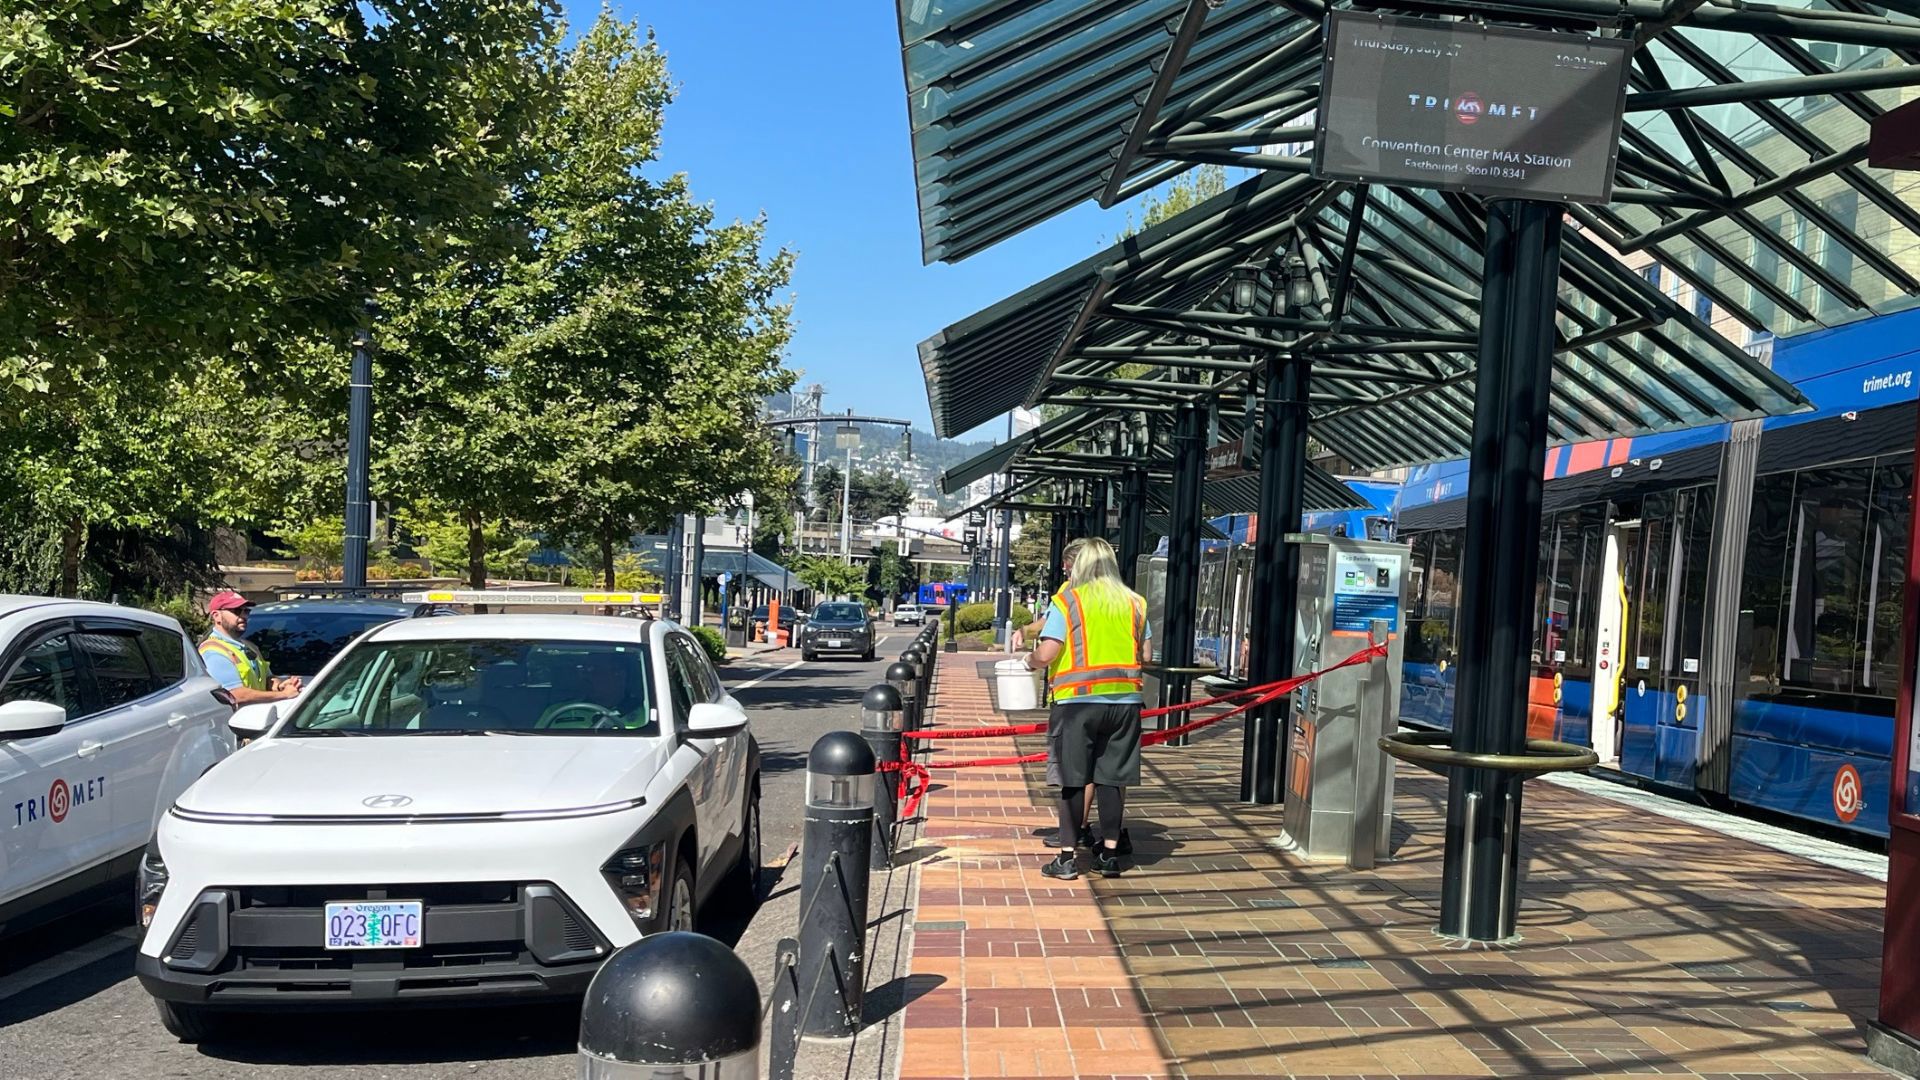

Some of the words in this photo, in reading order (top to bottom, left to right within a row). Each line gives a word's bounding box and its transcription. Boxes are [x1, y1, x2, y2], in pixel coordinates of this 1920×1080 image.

[1361, 135, 1441, 156] Convention
[1443, 144, 1491, 161] Center
[1491, 148, 1521, 164] MAX
[1523, 153, 1572, 169] Station
[1502, 167, 1526, 180] 8341
[1863, 370, 1913, 394] trimet.org
[355, 904, 390, 913] Oregon
